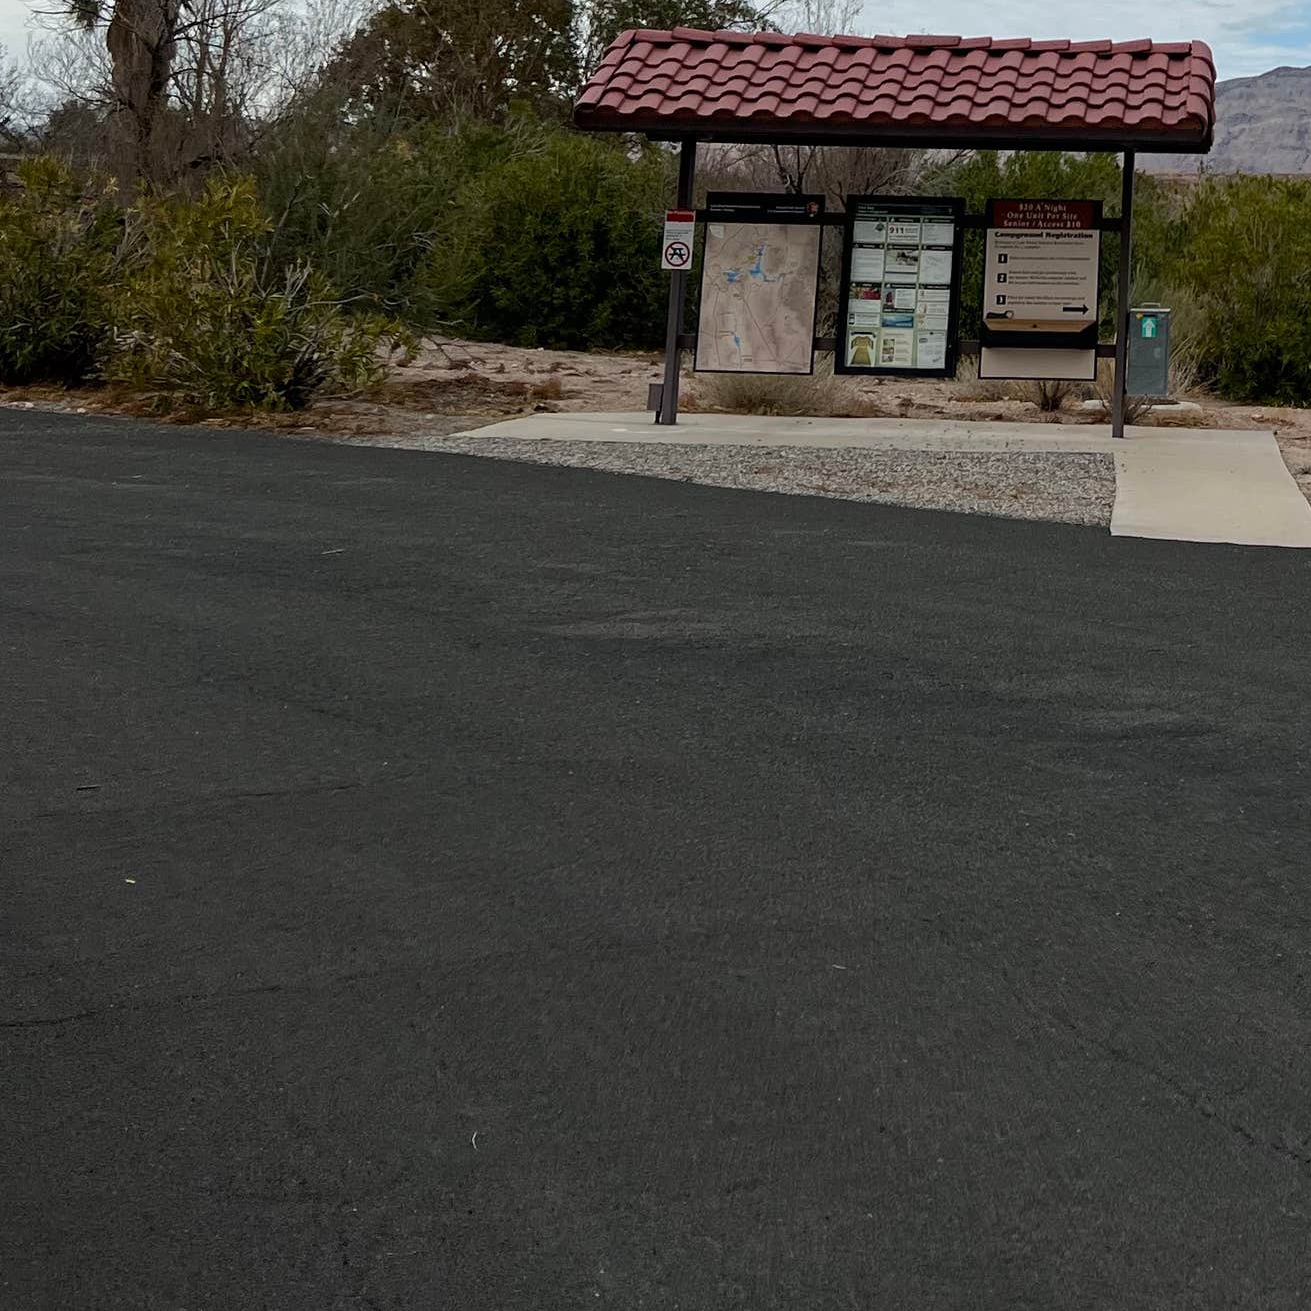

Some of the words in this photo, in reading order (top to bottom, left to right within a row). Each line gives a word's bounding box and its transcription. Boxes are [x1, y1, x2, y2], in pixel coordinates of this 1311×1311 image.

[1044, 203, 1067, 213] Night
[1006, 211, 1023, 219] One
[1026, 211, 1044, 219] Unit
[1062, 212, 1078, 220] Site
[1003, 219, 1030, 227] Senior
[889, 226, 905, 234] 911
[994, 231, 1043, 239] Campground
[1045, 232, 1093, 240] Registration
